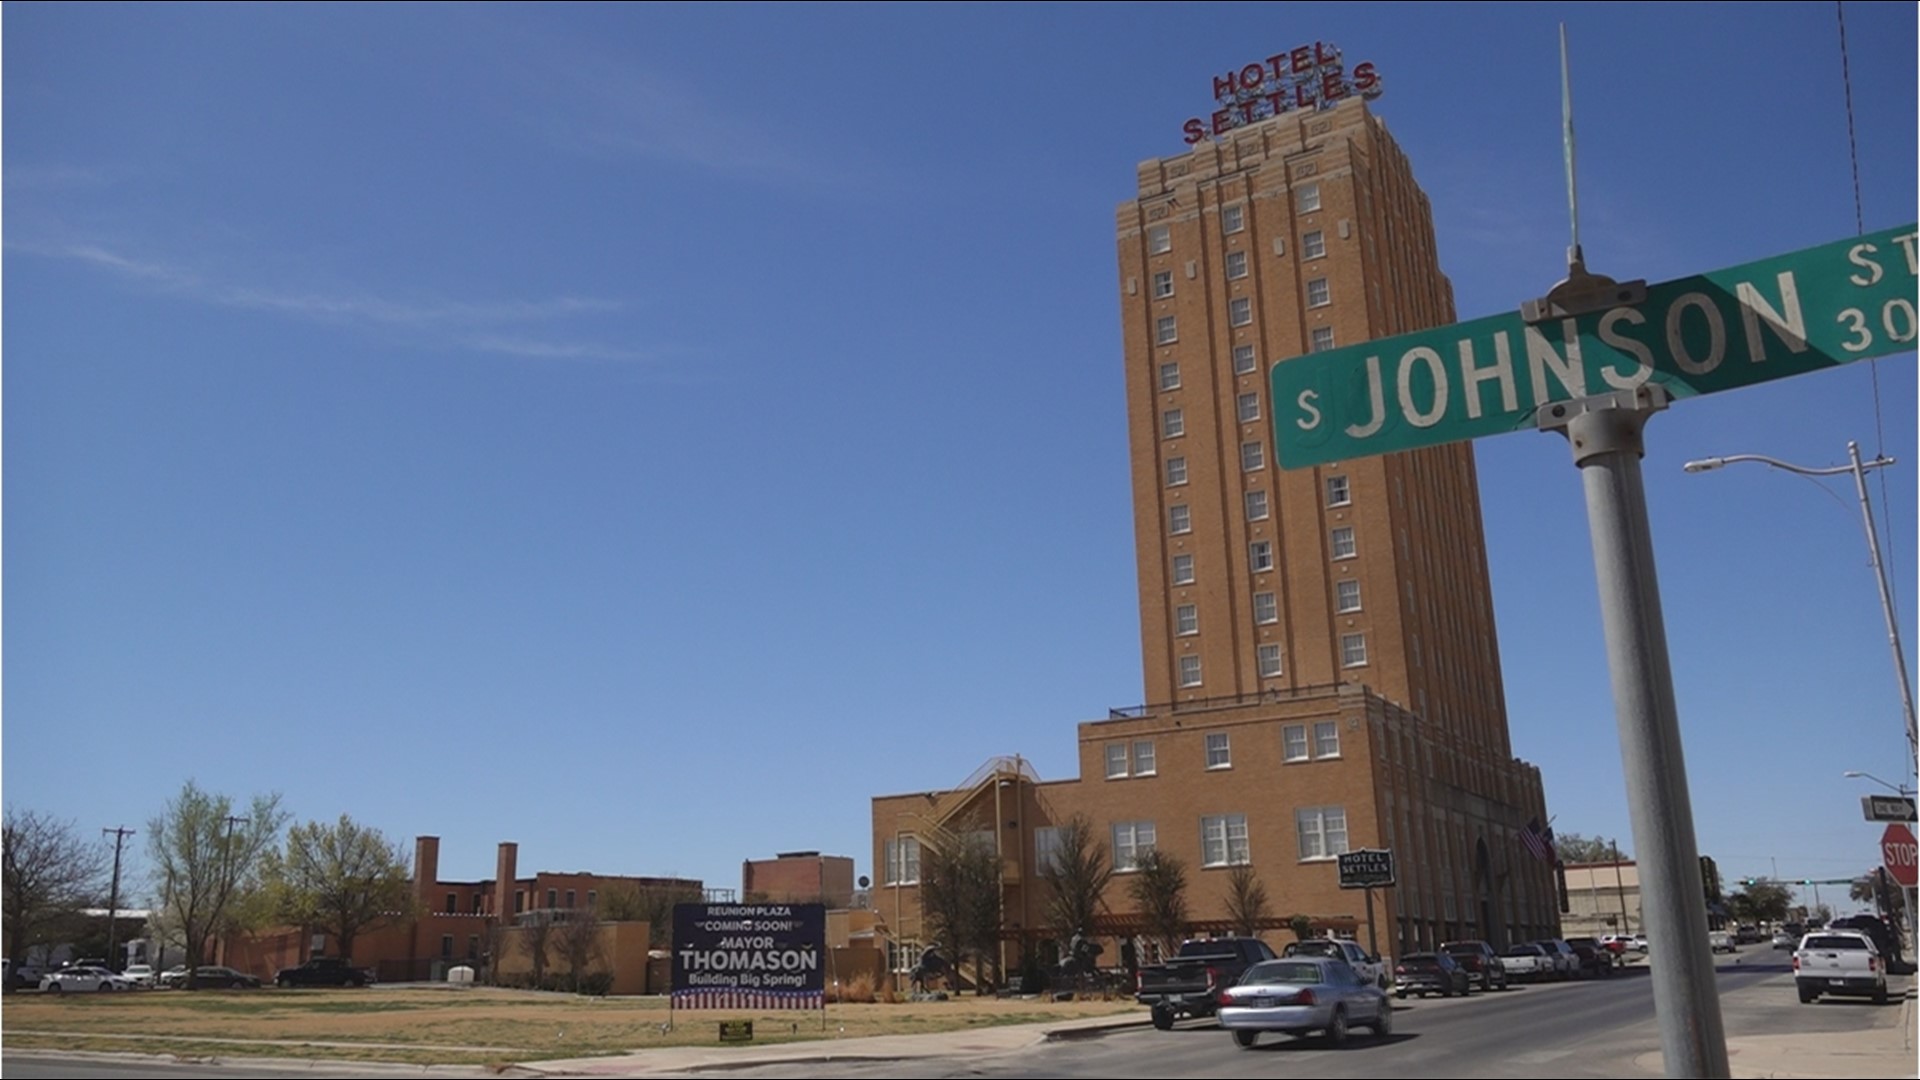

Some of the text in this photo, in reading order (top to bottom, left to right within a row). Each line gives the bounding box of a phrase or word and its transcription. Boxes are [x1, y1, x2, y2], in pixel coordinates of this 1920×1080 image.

[1212, 41, 1336, 100] HOTEL
[1182, 62, 1378, 145] SETTLES
[1847, 231, 1918, 287] ST
[1296, 270, 1810, 439] S JOHNSON
[1344, 853, 1383, 863] HOTEL
[1885, 842, 1918, 867] STOP
[1342, 863, 1388, 874] SETTLES
[707, 906, 792, 917] REUNION PLAZA
[705, 920, 793, 932] COMING SOON!
[721, 936, 774, 949] MAYOR
[679, 950, 818, 970] THOMASON
[688, 973, 807, 987] Building Big Spring!
